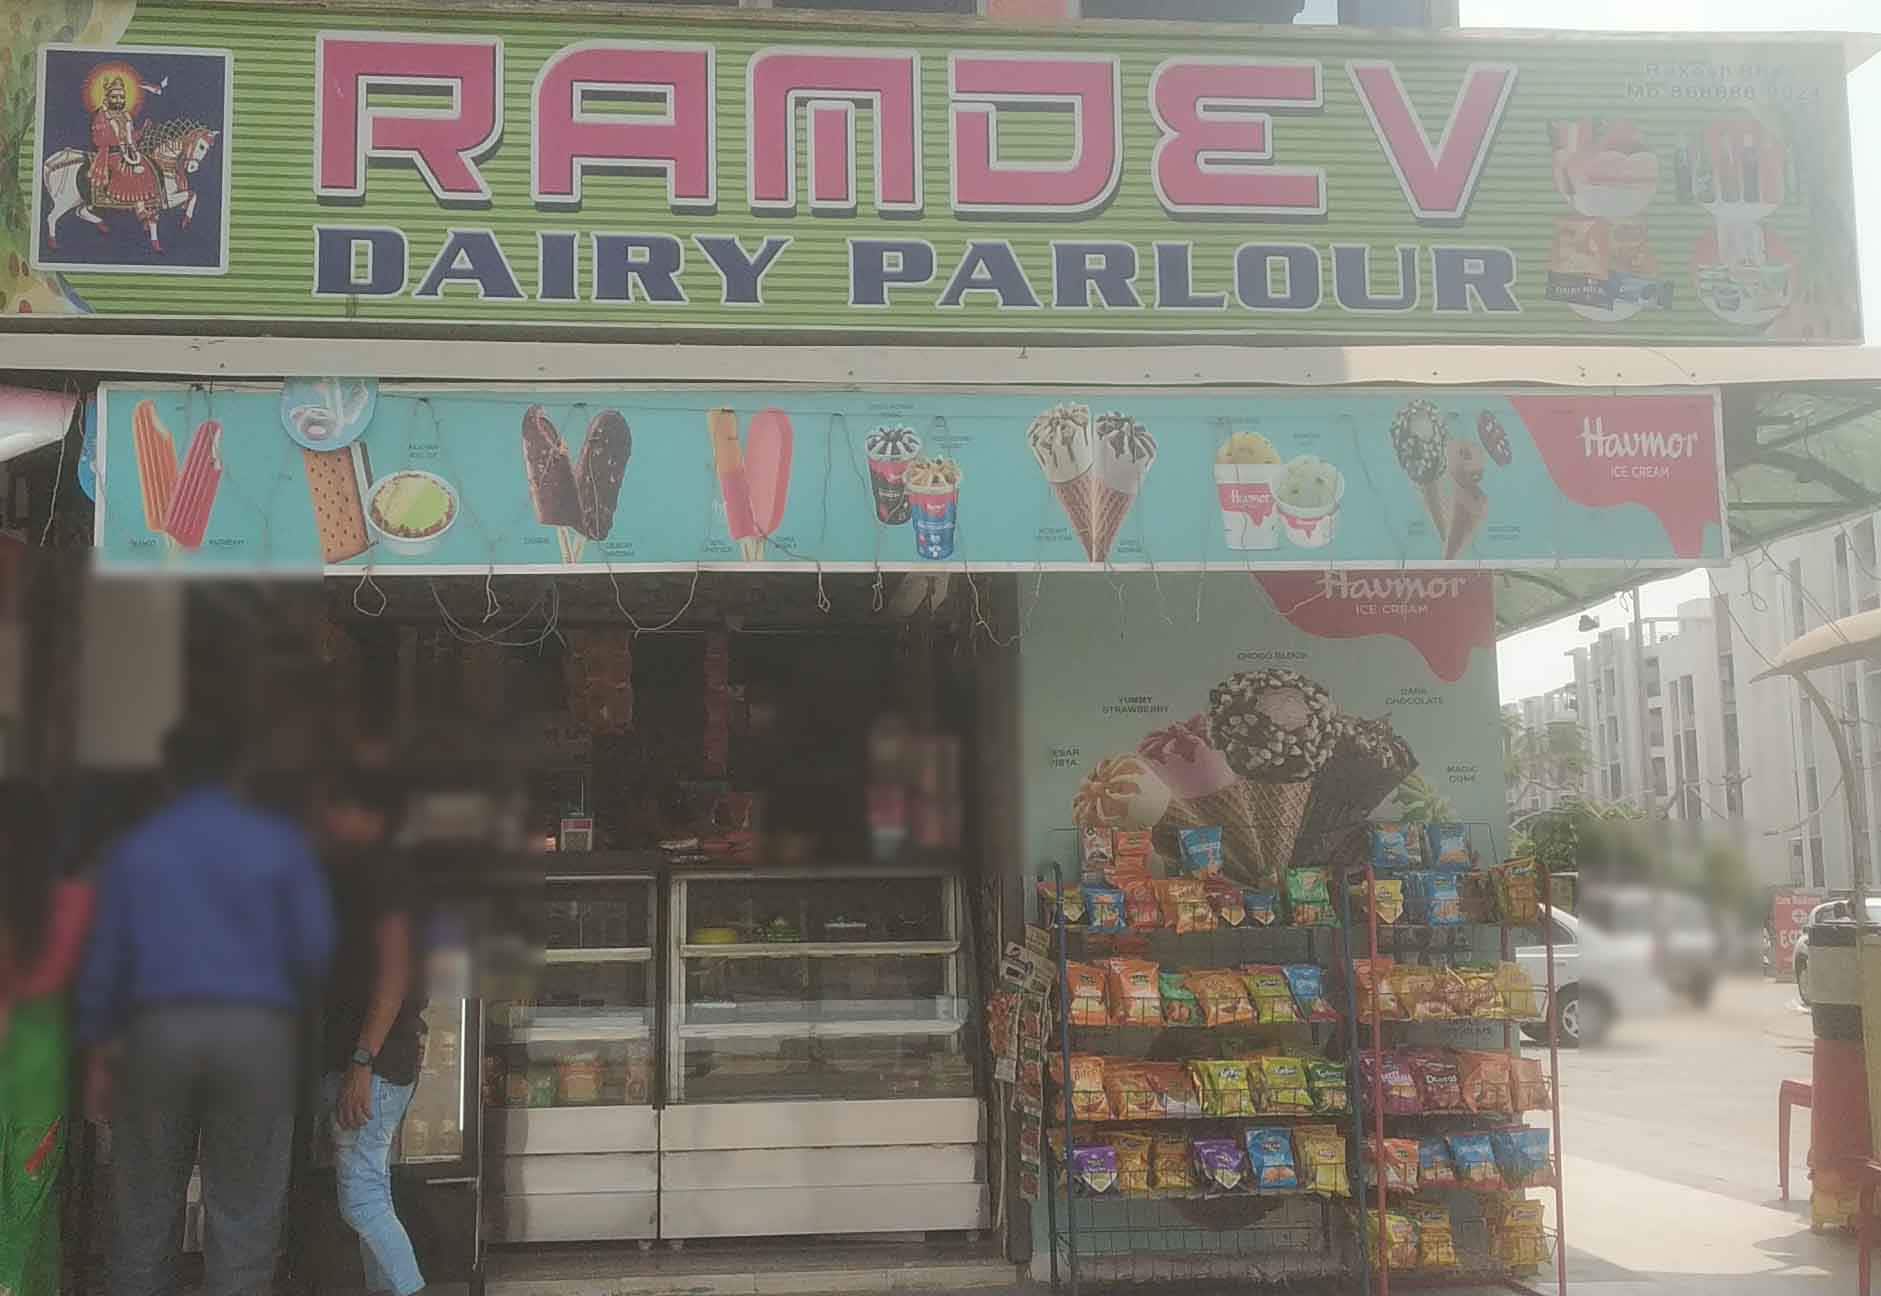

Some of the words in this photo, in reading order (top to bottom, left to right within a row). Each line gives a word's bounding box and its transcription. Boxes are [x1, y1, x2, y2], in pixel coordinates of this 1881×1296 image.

[315, 31, 1518, 222] RAMDEV
[312, 225, 793, 308] DAIRY
[845, 236, 1521, 315] PARLOUR
[1577, 416, 1698, 459] Havmor
[1610, 465, 1630, 479] ICE
[1631, 465, 1670, 479] CREAM
[1317, 570, 1465, 600] Havmor
[1355, 604, 1377, 616] ICE
[1381, 604, 1429, 616] CREAM
[1102, 704, 1169, 713] STRAWBERRY
[1384, 696, 1444, 705] CHOCOLATE
